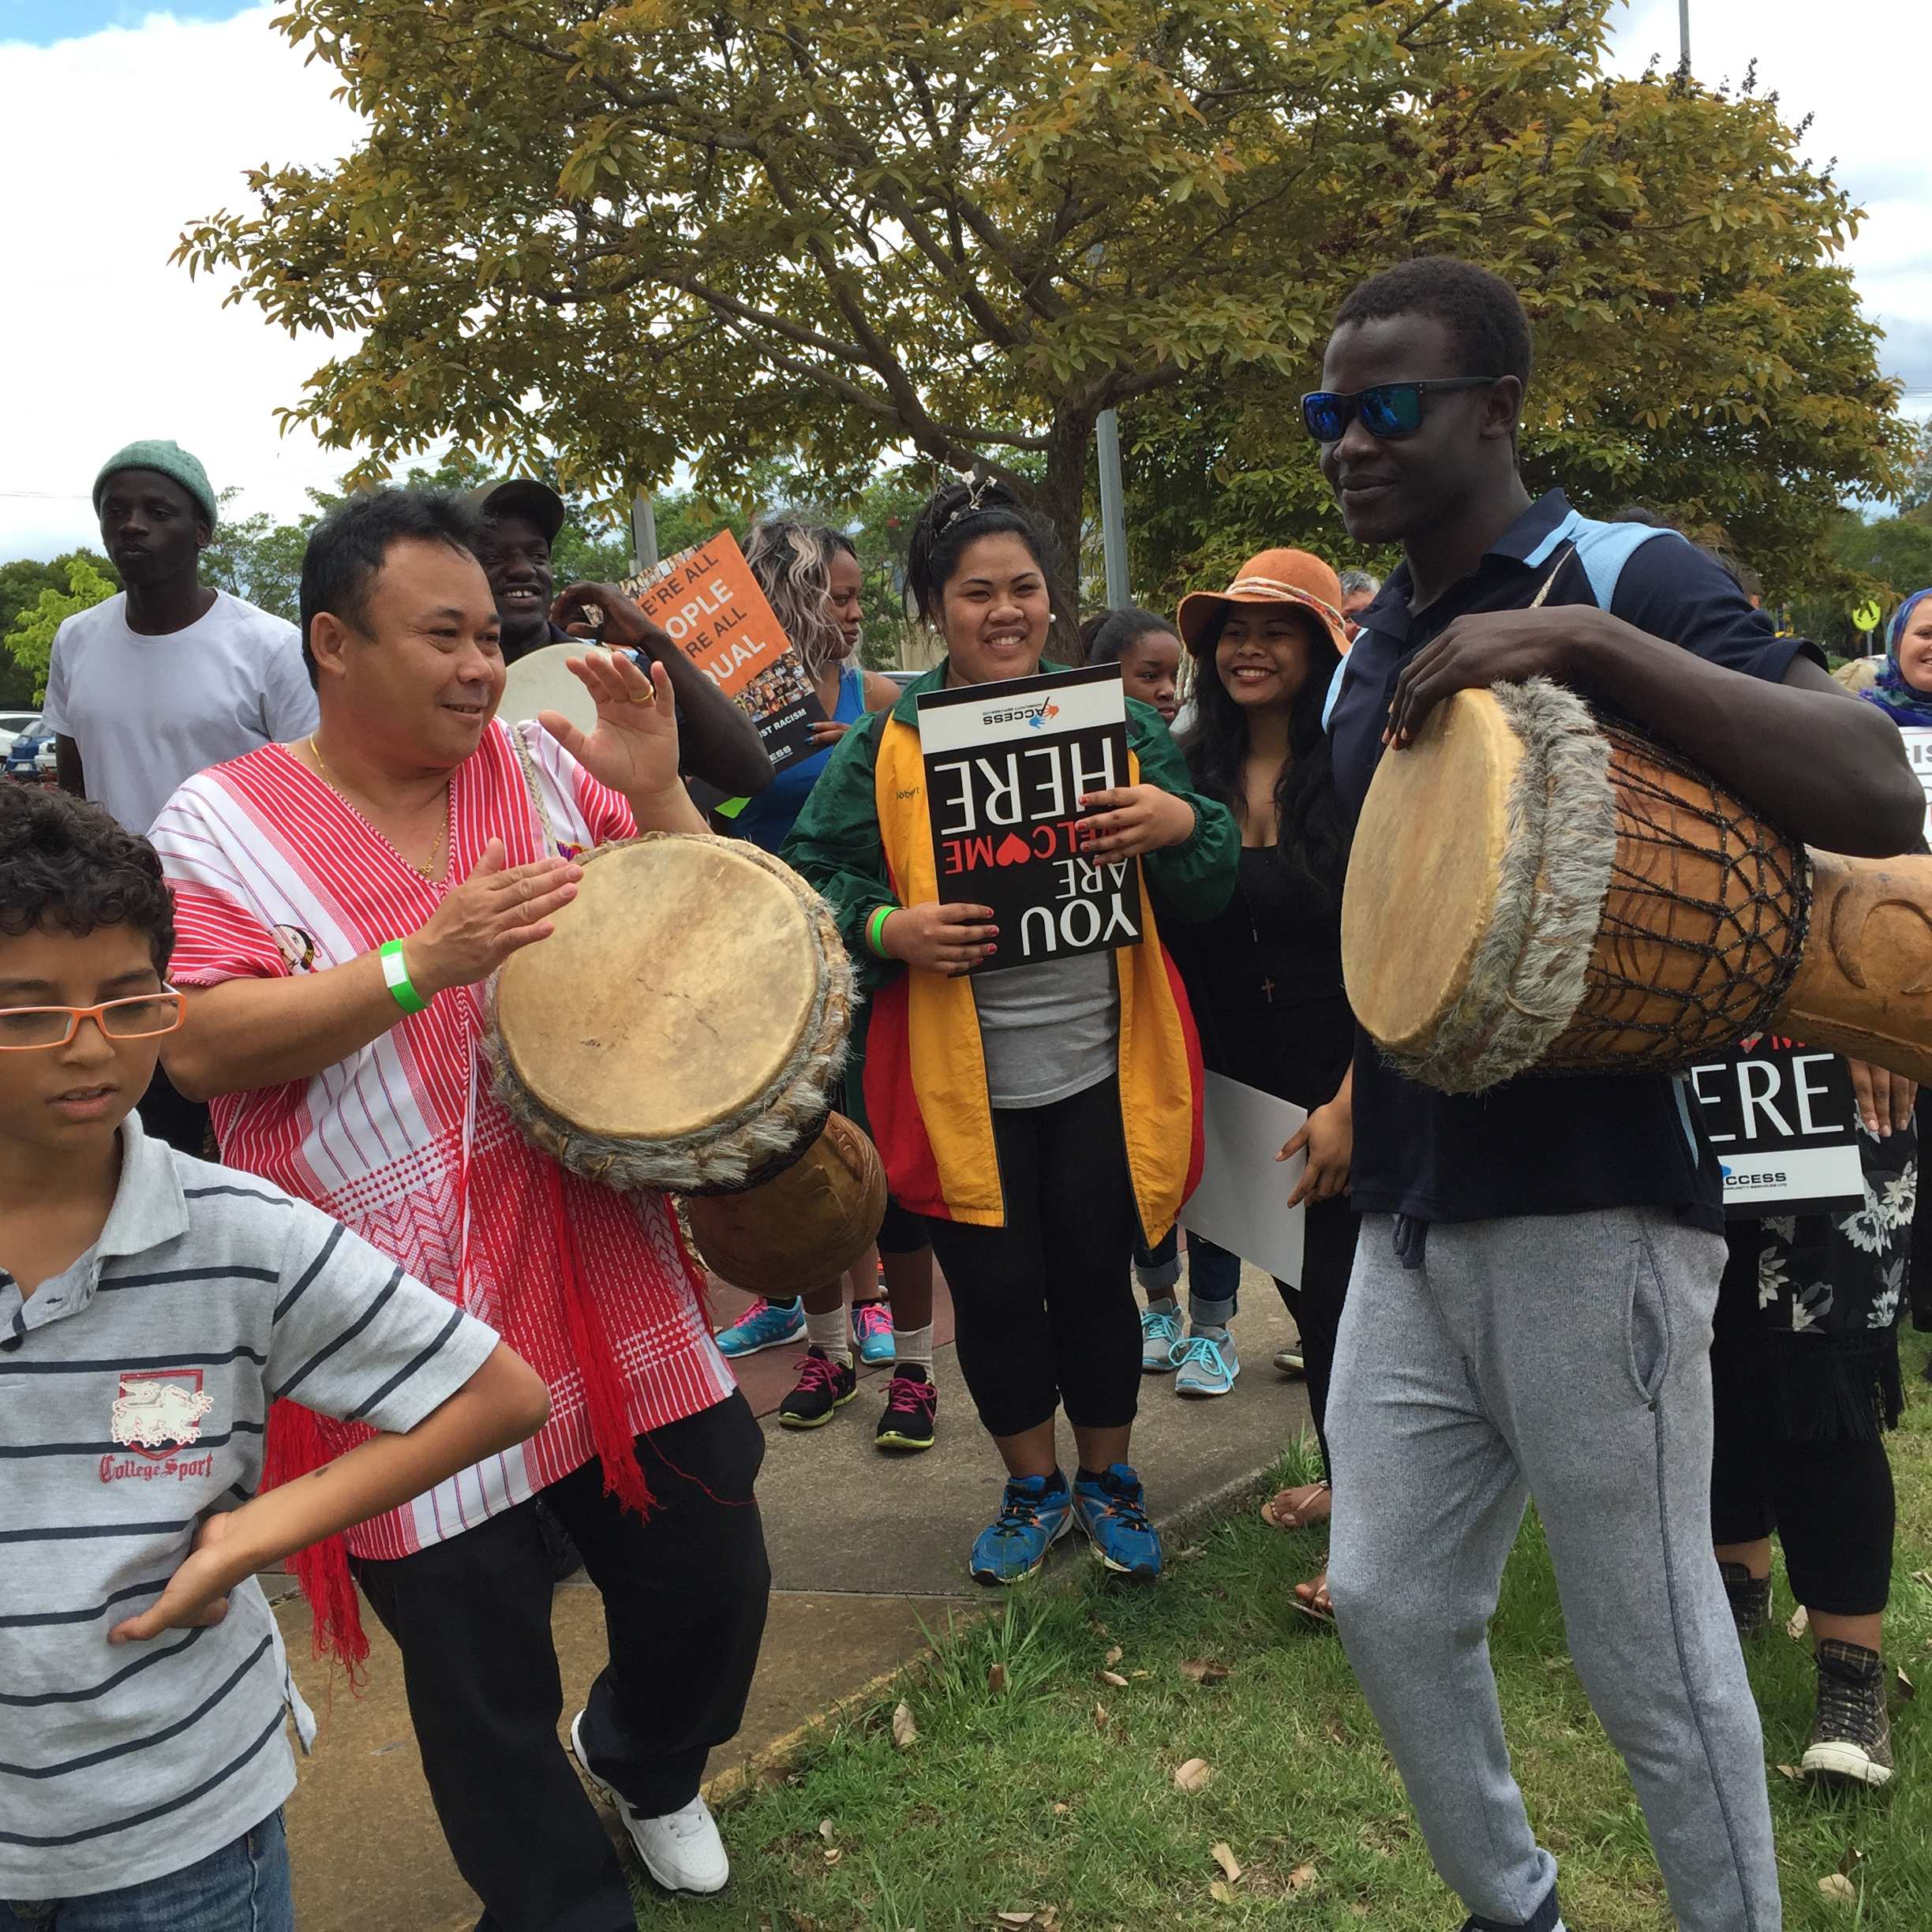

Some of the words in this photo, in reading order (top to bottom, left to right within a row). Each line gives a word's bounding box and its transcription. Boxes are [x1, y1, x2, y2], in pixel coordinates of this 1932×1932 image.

[639, 578, 684, 616] E'RE
[684, 553, 719, 584] ALL
[665, 578, 734, 639] OPLE
[680, 631, 713, 659] 'RE
[713, 605, 747, 638] ALL
[773, 708, 807, 731] RACISM
[983, 696, 1050, 724] ACCESS
[769, 745, 792, 762] ESS
[934, 737, 1116, 835] HERE
[1052, 857, 1130, 900] ARE
[1020, 893, 1139, 956] YOU
[1691, 1053, 1844, 1142] ERE
[1725, 1172, 1787, 1185] CCESS
[99, 1452, 161, 1484] College
[161, 1451, 214, 1481] Sport
